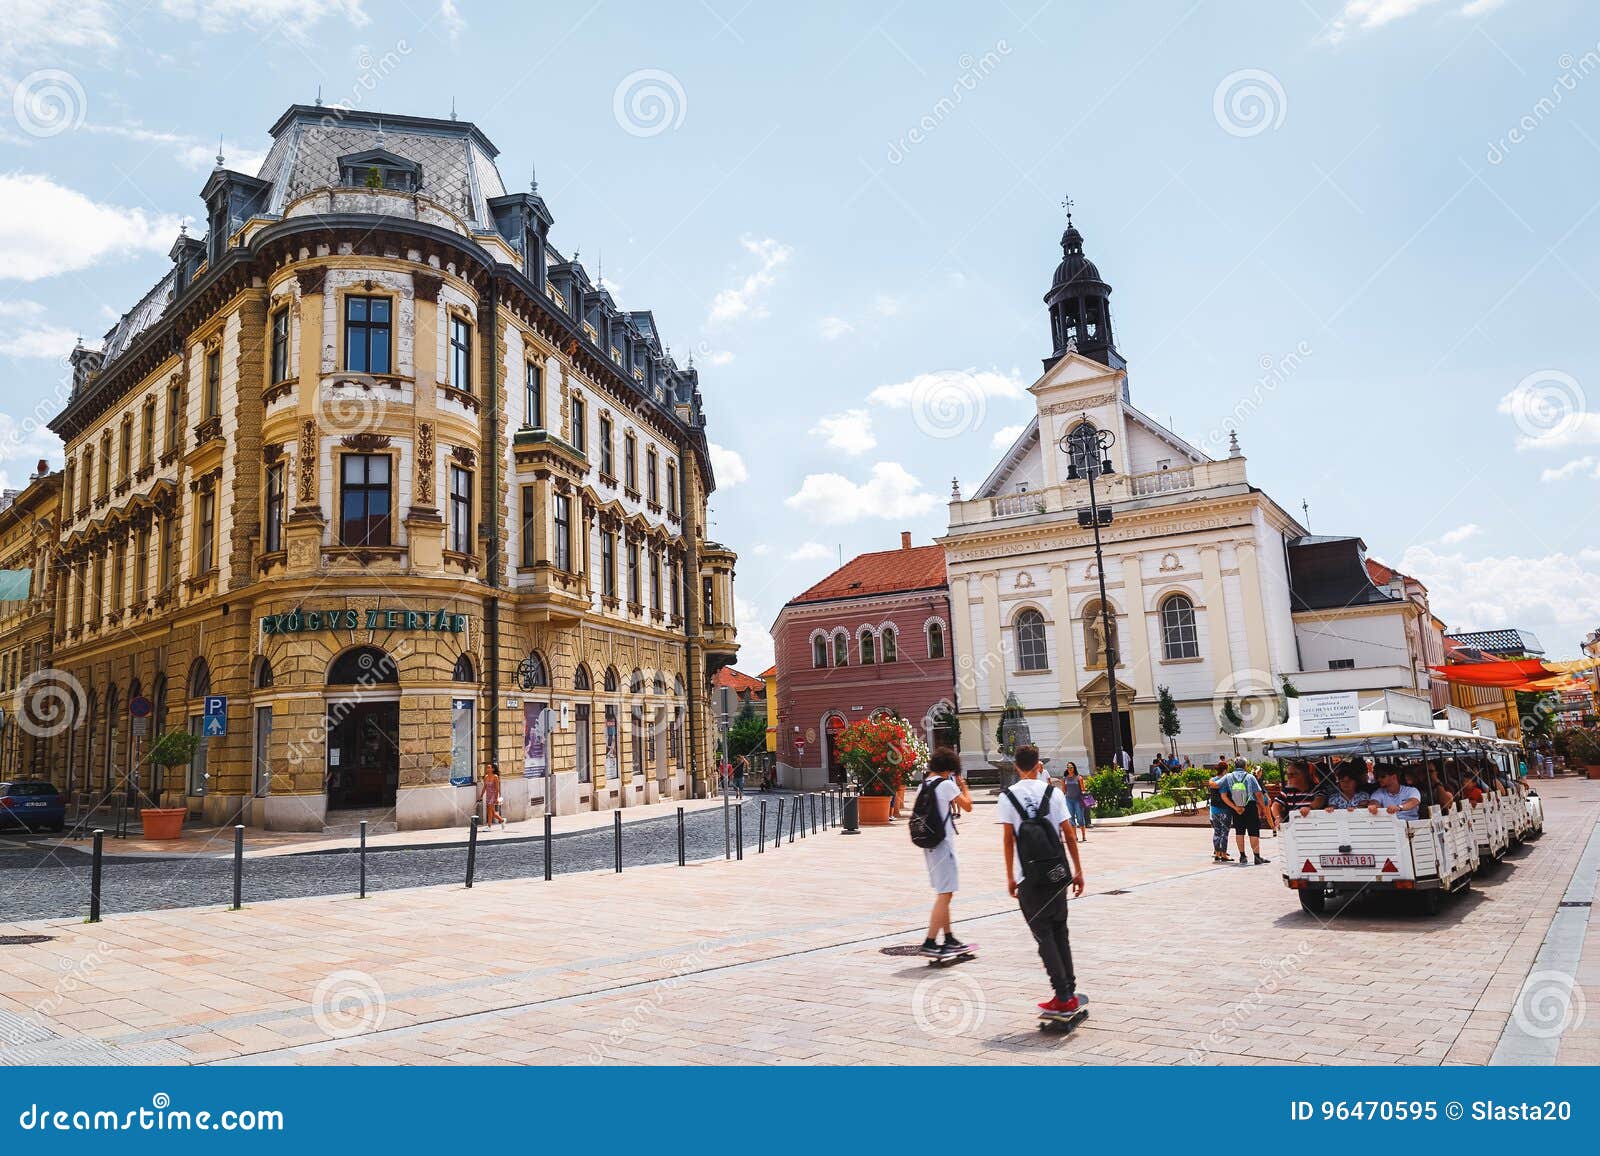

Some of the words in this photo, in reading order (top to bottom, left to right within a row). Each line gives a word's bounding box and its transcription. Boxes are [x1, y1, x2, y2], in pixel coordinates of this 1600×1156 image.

[969, 544, 1024, 558] SEBASTIANO
[1052, 534, 1099, 547] SACRAT
[262, 608, 466, 633] GYÓGYSZERTÁR
[210, 699, 222, 714] P
[1329, 856, 1373, 865] YAN-181
